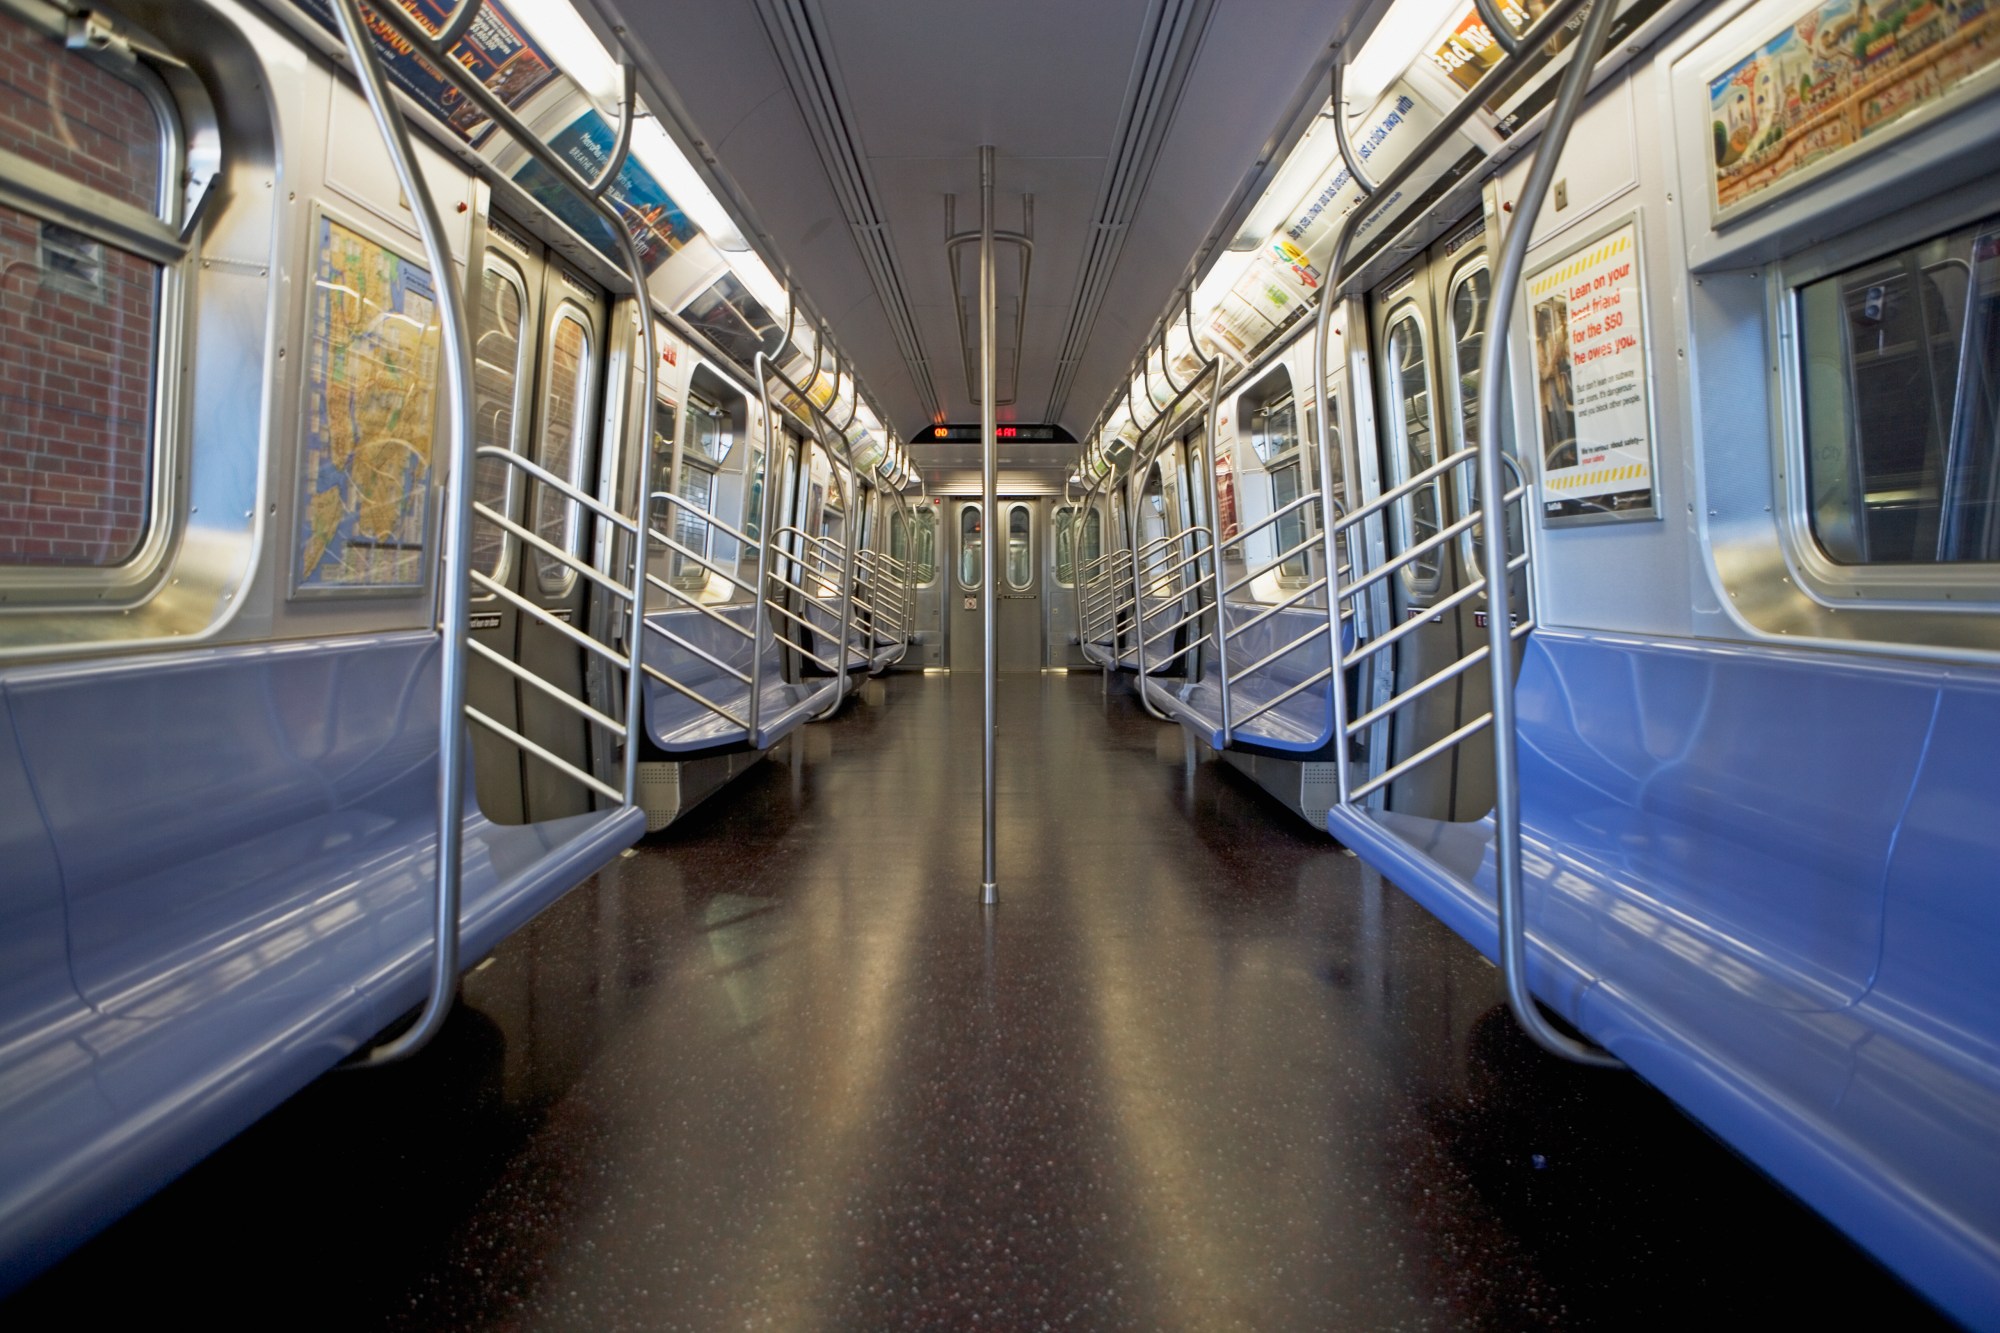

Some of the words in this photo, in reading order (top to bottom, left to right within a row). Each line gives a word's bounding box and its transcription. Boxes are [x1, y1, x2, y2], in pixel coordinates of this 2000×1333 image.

[1431, 40, 1475, 73] Bad
[1395, 95, 1415, 115] with
[1382, 110, 1404, 132] away
[580, 132, 603, 158] MetroPlus
[1366, 140, 1376, 150] a
[1370, 125, 1388, 145] click
[568, 146, 593, 171] BREATHE
[1318, 192, 1330, 207] and
[1325, 186, 1338, 199] bus
[1570, 282, 1591, 302] Lean
[1593, 275, 1606, 290] on
[1608, 263, 1630, 287] your
[1592, 288, 1621, 314] friend
[1572, 329, 1586, 344] for
[1587, 322, 1602, 340] the
[1604, 311, 1623, 332] $50
[1573, 351, 1586, 366] he
[1588, 342, 1612, 361] owes
[1615, 334, 1637, 354] you.
[1576, 384, 1585, 393] But
[1597, 377, 1607, 387] lean
[1615, 370, 1634, 381] subway
[1578, 409, 1588, 417] and
[1588, 407, 1596, 417] you
[1596, 403, 1609, 413] block
[1609, 399, 1622, 409] other
[1004, 428, 1017, 436] AM
